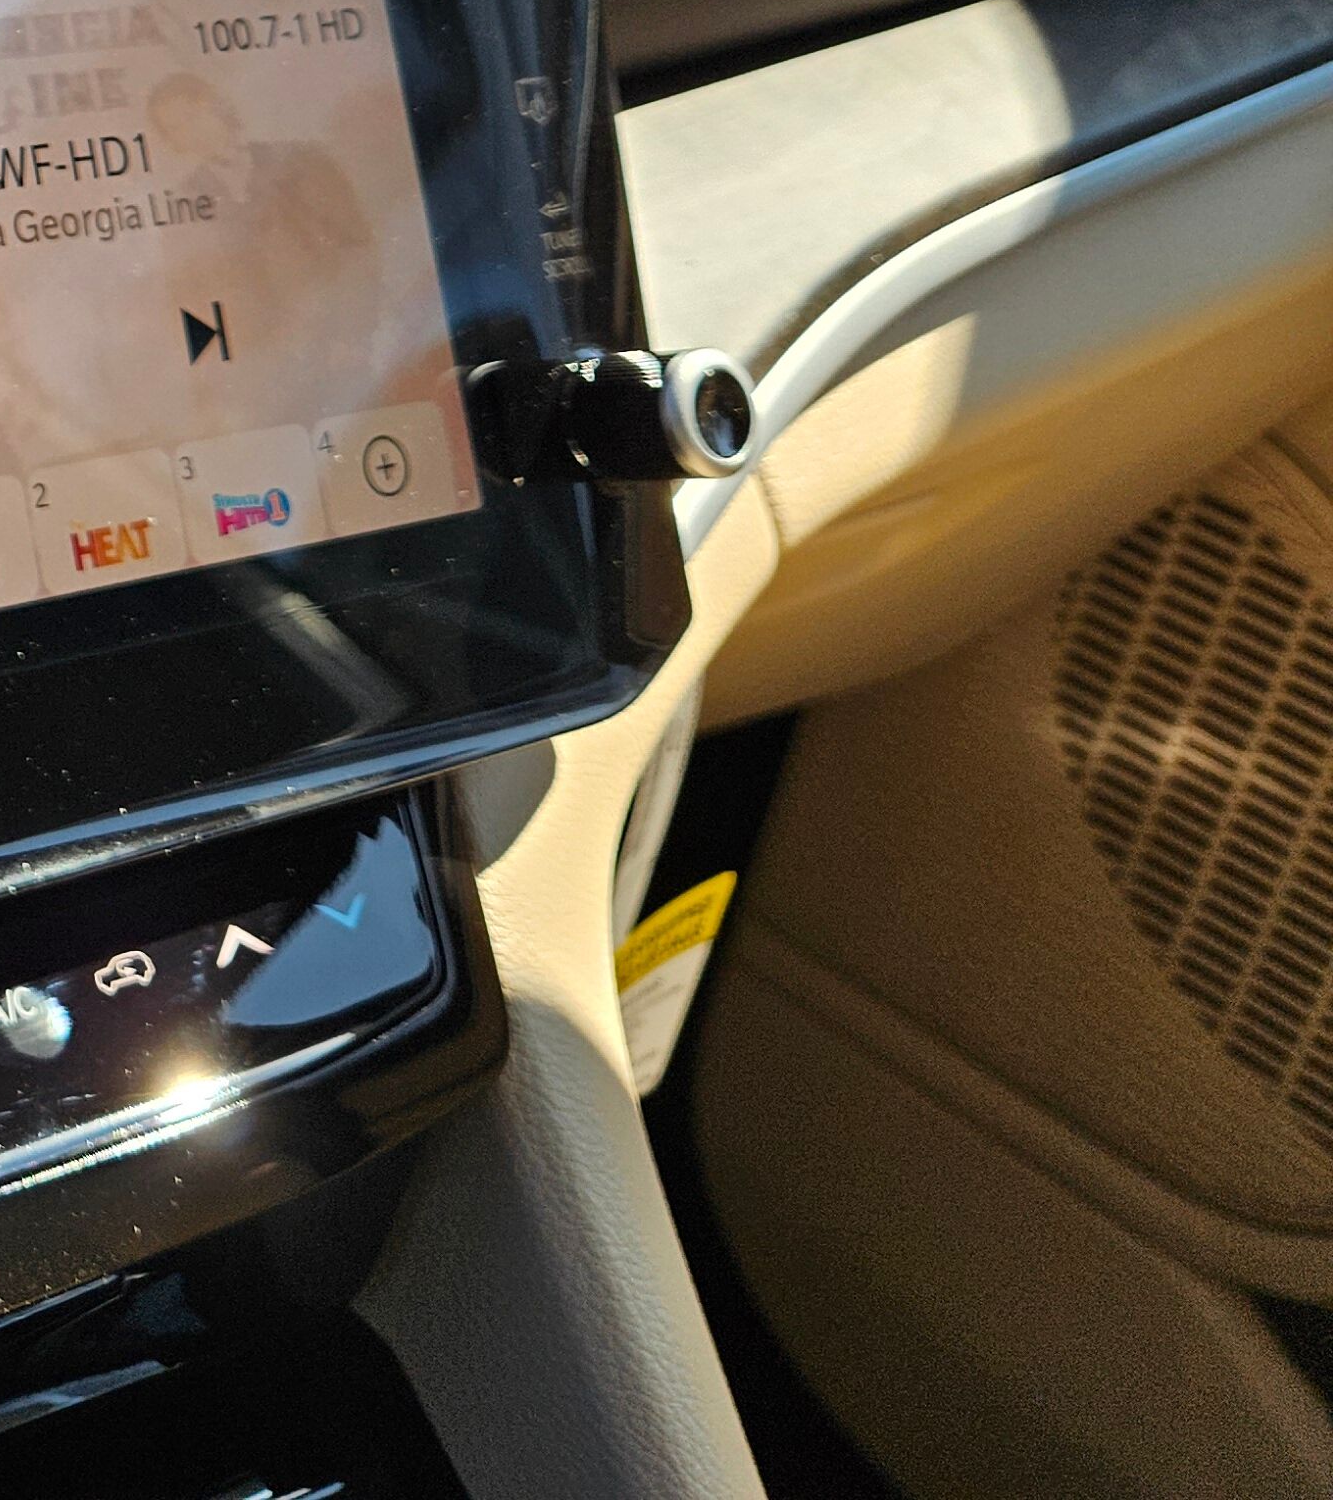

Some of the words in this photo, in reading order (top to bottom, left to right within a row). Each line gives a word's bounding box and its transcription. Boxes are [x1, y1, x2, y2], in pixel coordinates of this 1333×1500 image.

[194, 13, 307, 53] 100.7-1
[317, 8, 363, 43] HD
[15, 198, 142, 243] Georgia
[148, 188, 215, 227] Line
[317, 431, 333, 456] 4
[180, 456, 195, 481] 3
[33, 483, 49, 508] 2
[70, 518, 151, 572] HEAT
